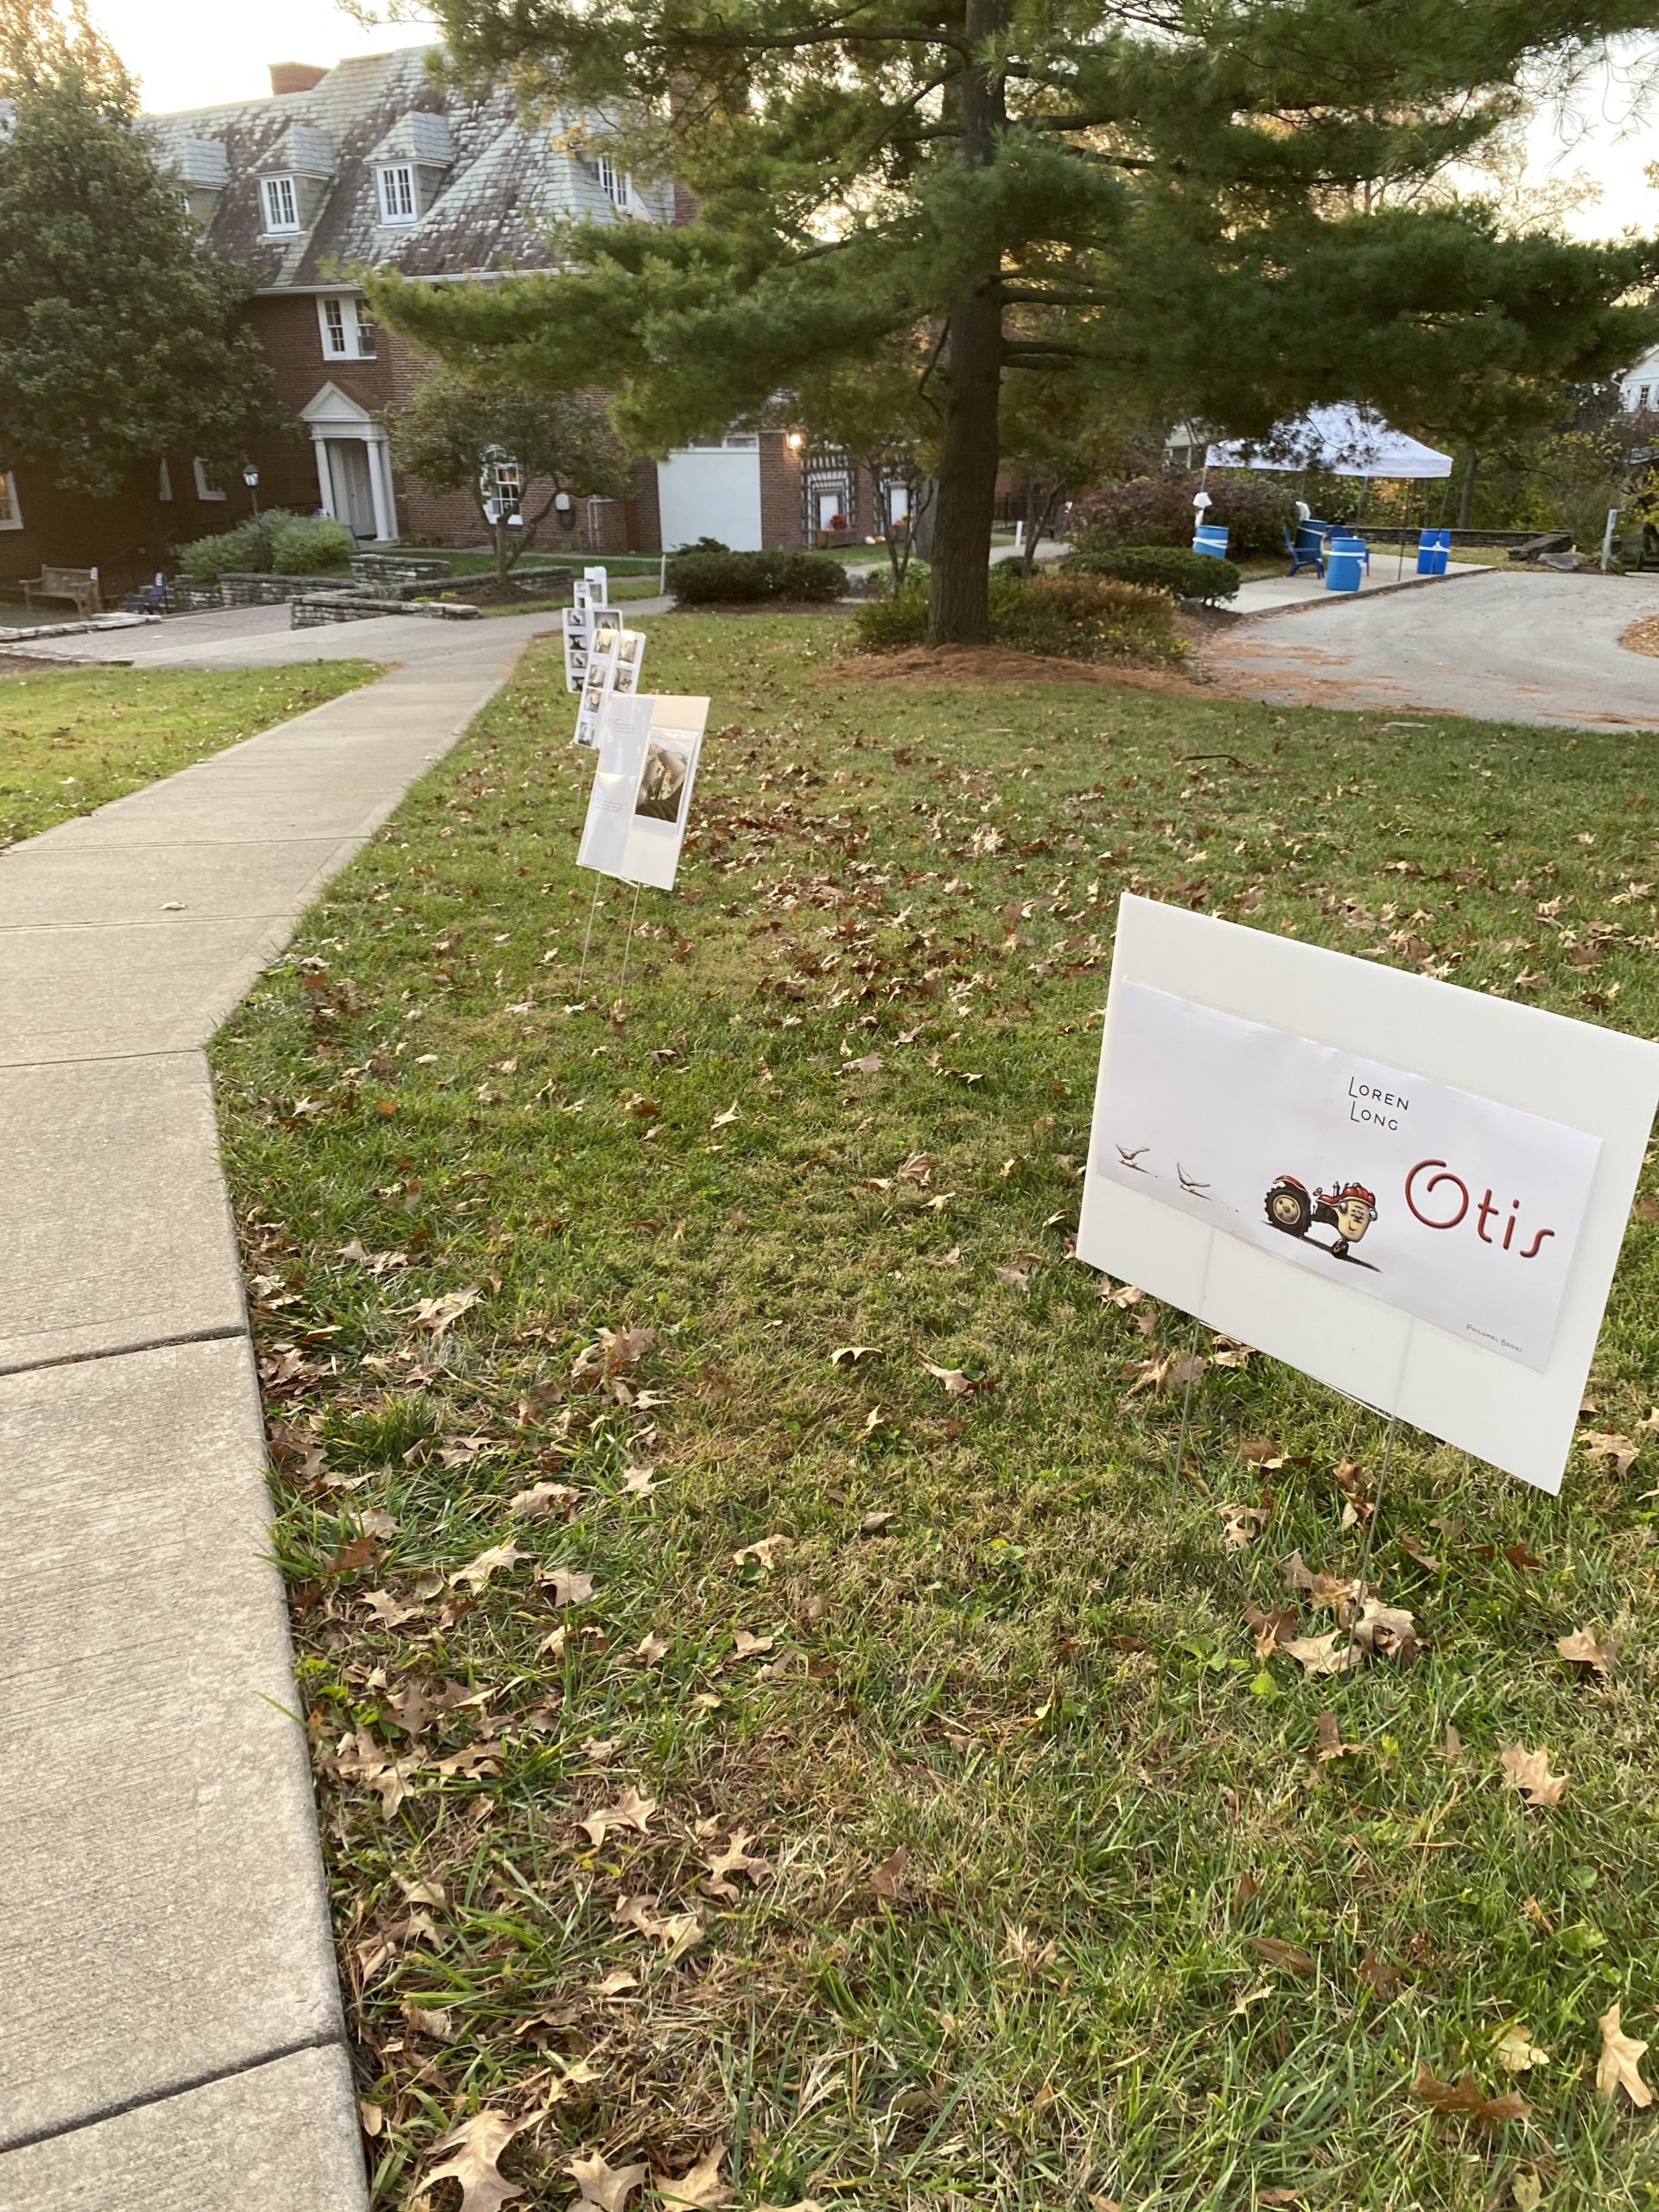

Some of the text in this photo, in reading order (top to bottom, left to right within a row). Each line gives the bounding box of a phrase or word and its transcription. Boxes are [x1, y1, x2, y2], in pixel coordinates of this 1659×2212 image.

[1348, 1076, 1409, 1110] LOREN
[1351, 1100, 1398, 1130] LONG
[1405, 1159, 1555, 1258] Otis
